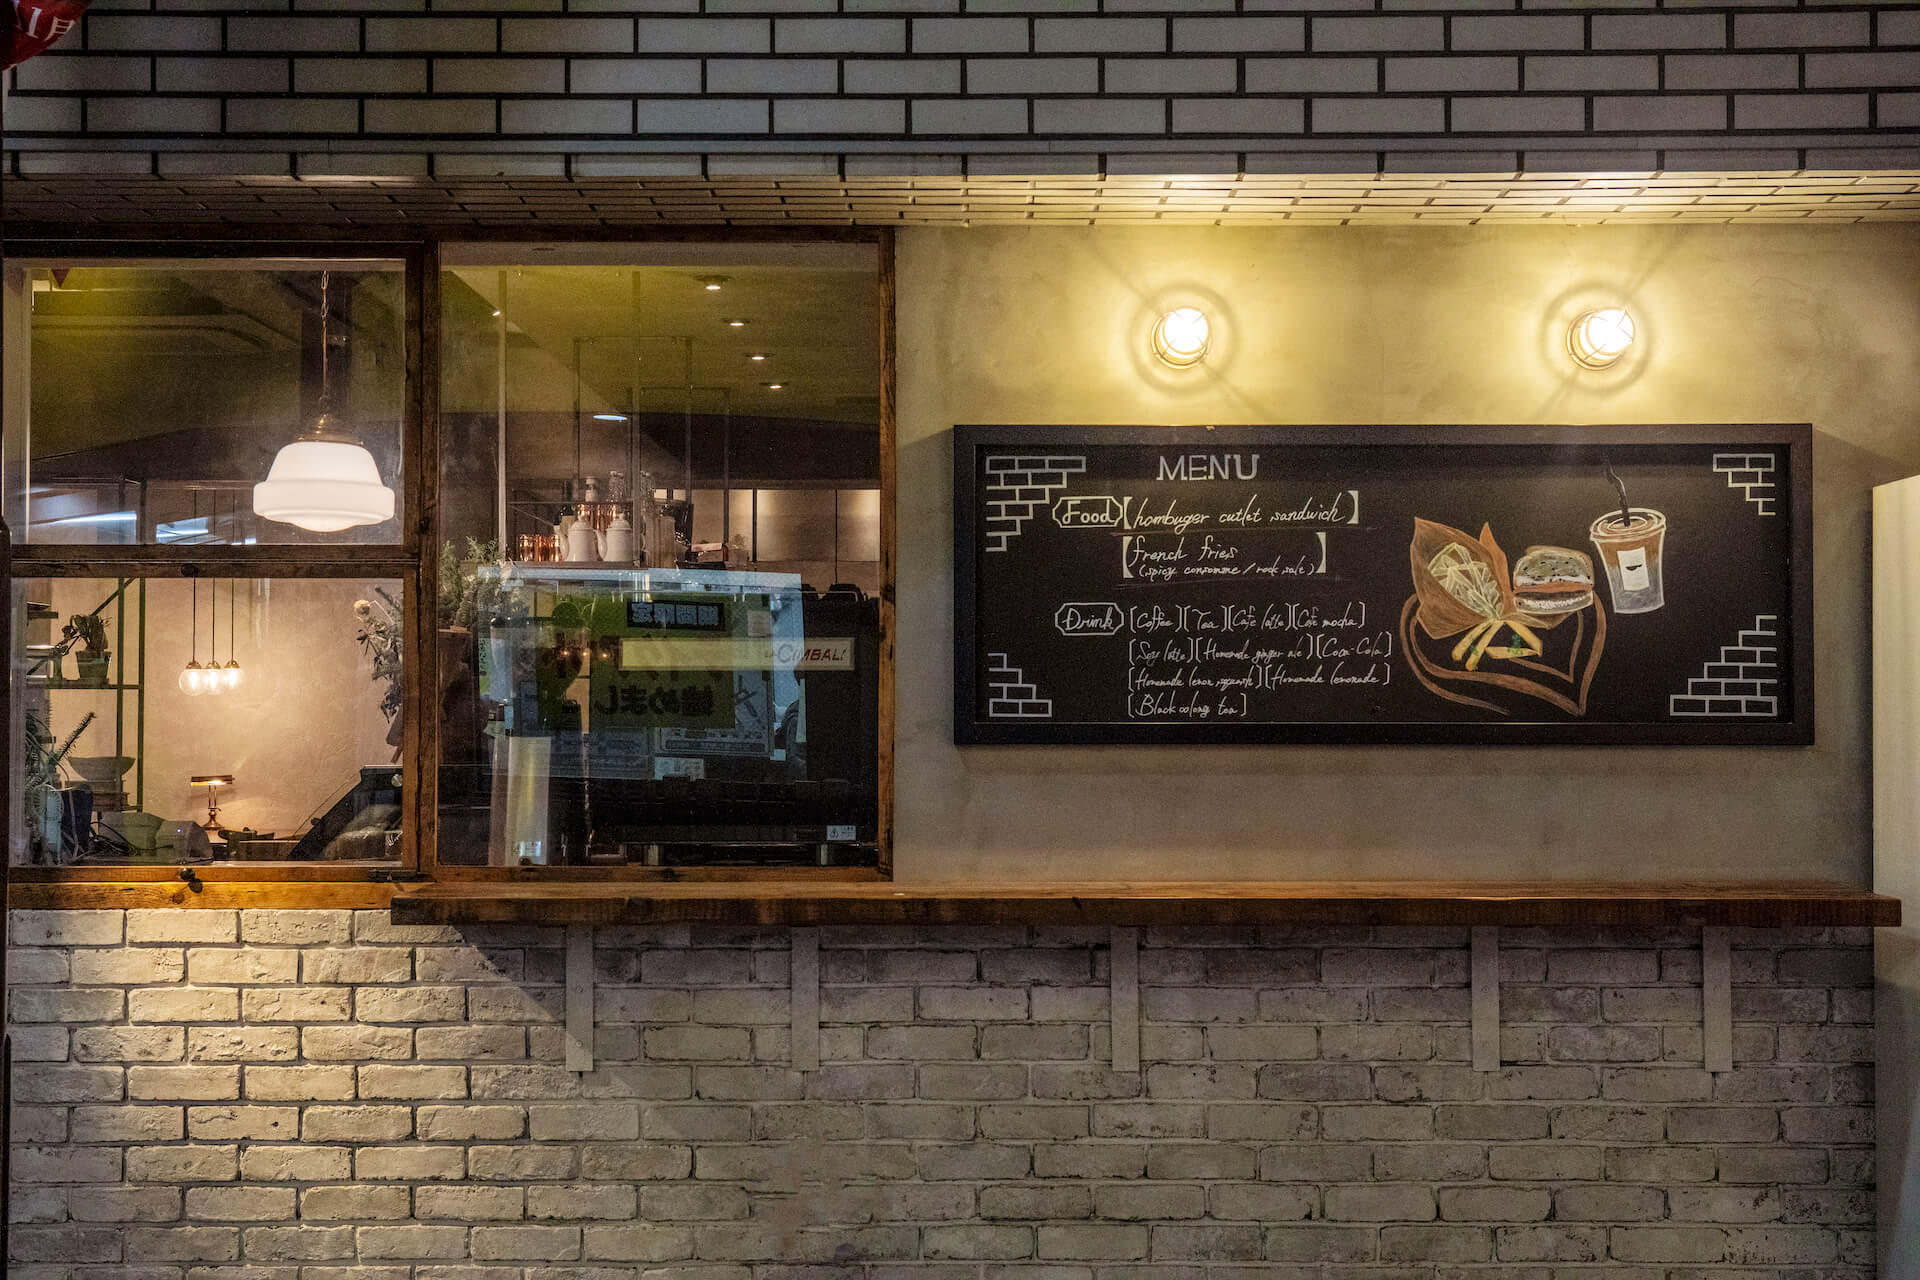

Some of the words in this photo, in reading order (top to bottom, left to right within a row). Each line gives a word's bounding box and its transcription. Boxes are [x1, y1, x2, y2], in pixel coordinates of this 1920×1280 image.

[1156, 454, 1260, 481] MENU
[1062, 499, 1116, 523] Food
[1218, 494, 1262, 526] cutlet
[1198, 535, 1239, 561] fries
[1061, 606, 1114, 631] Drink
